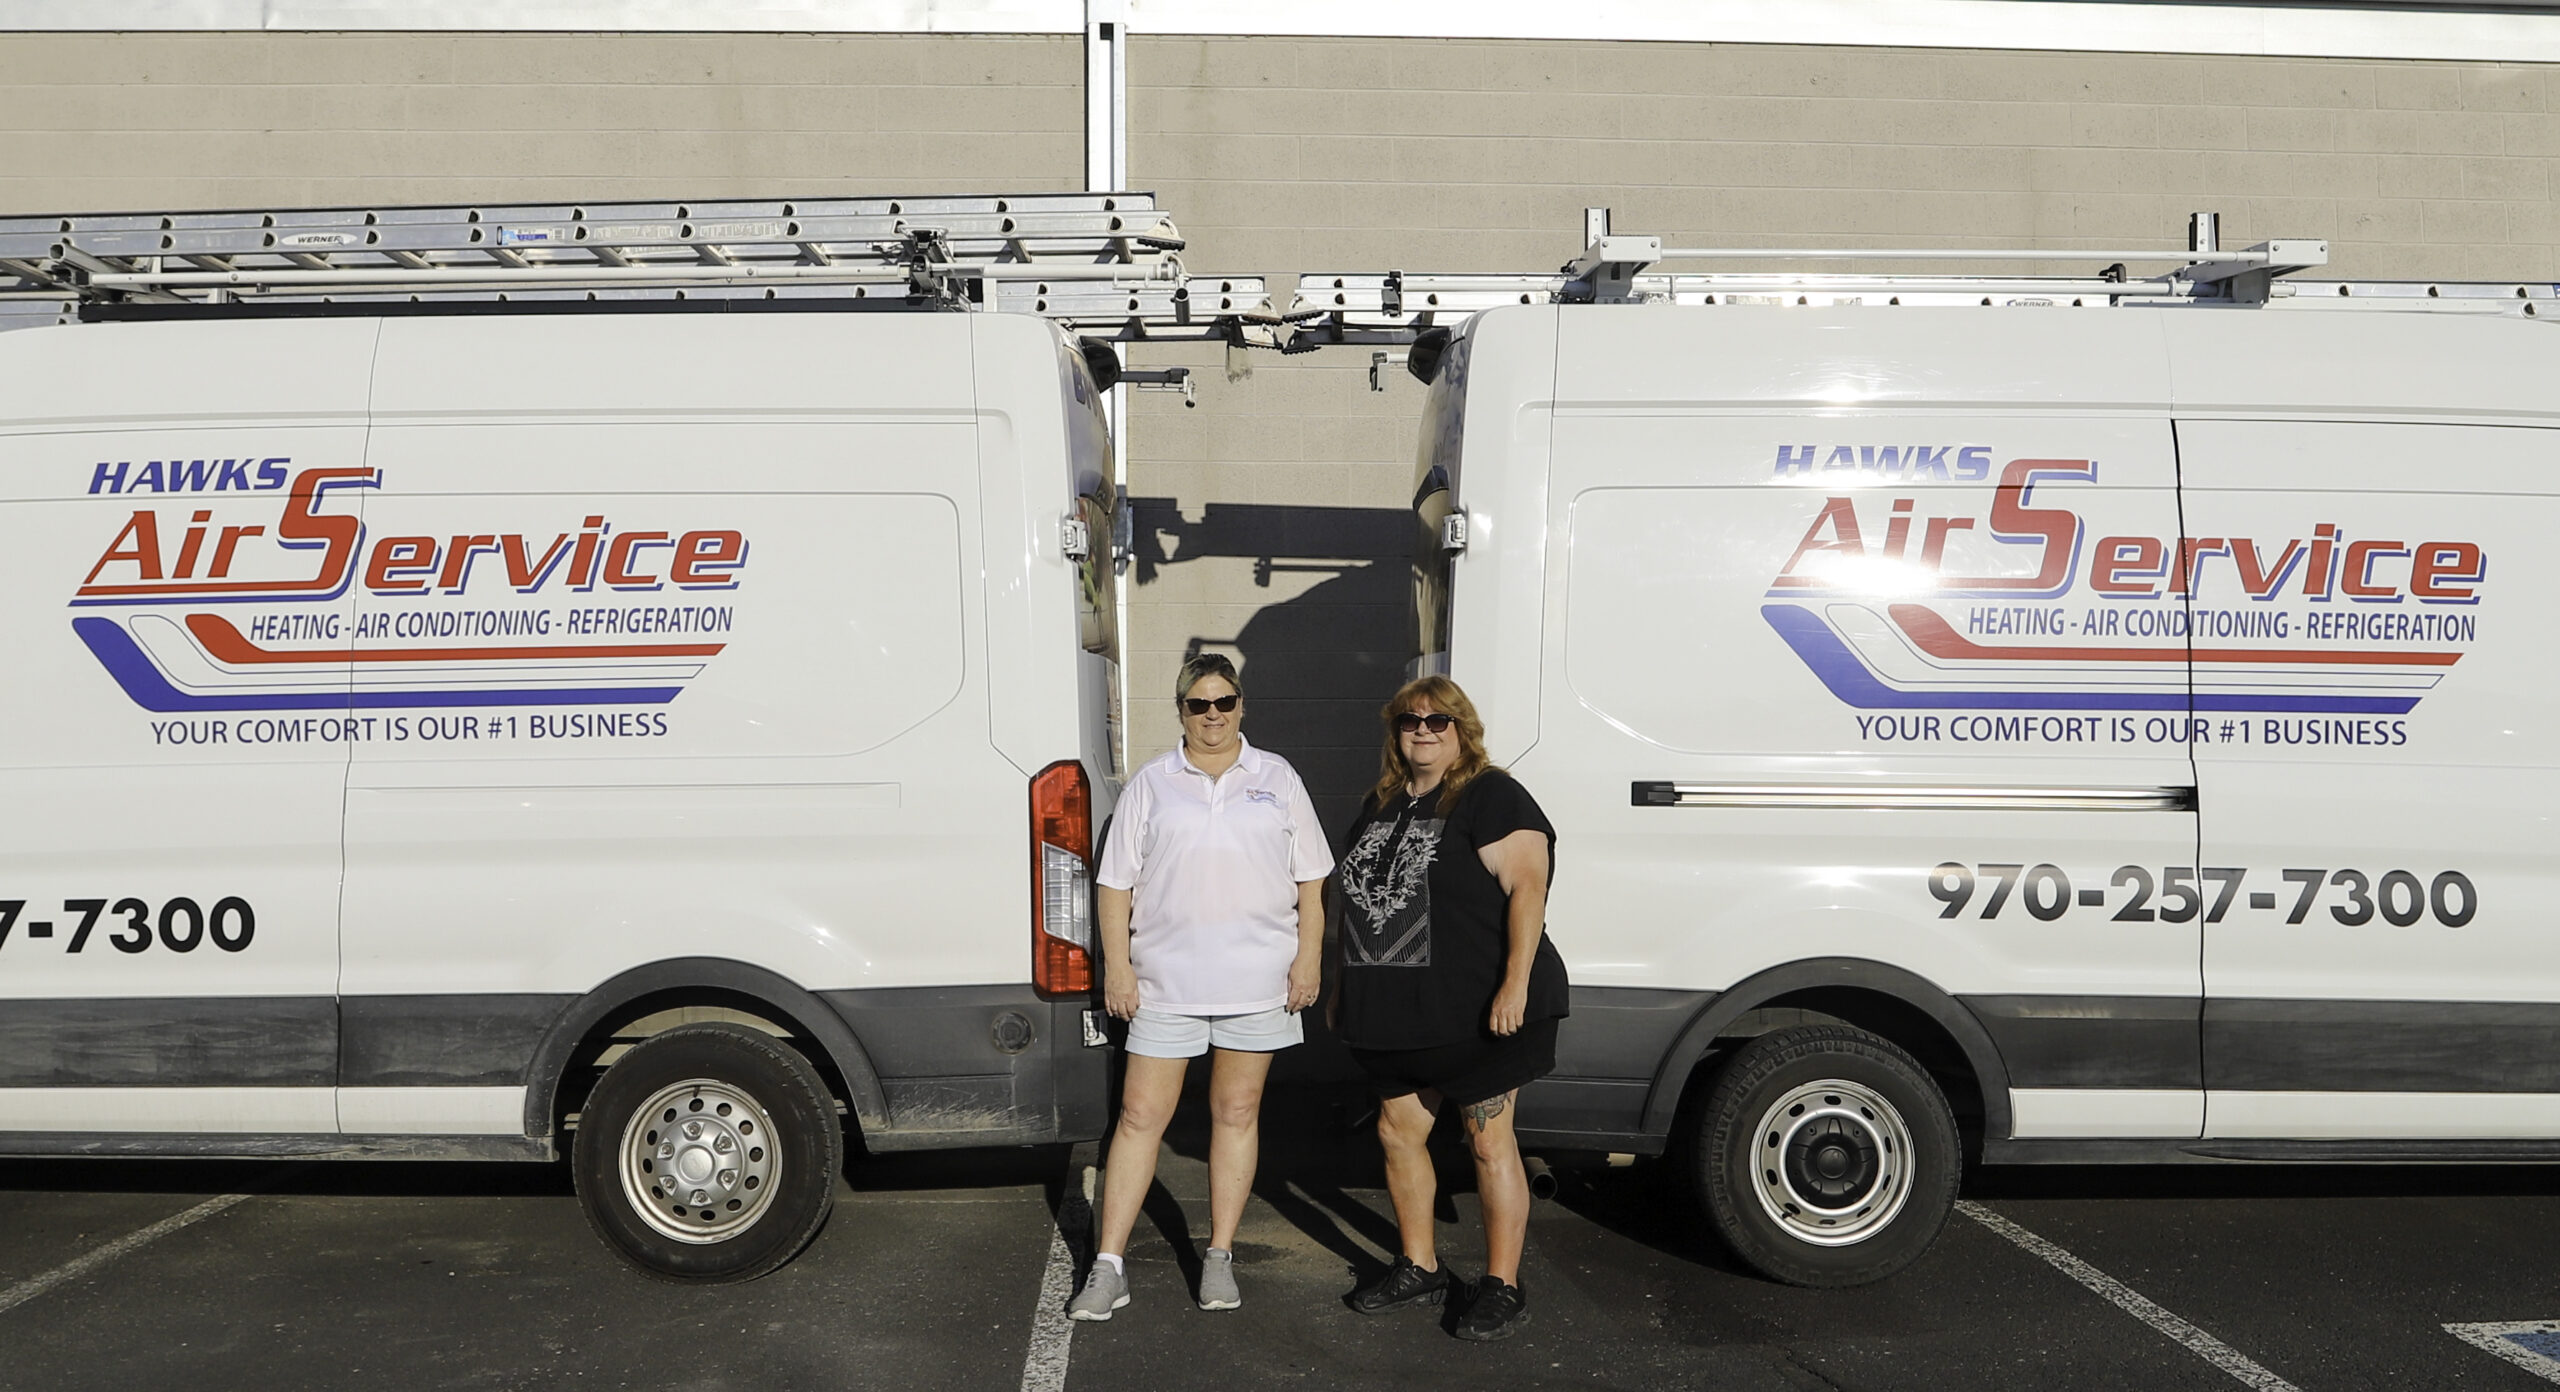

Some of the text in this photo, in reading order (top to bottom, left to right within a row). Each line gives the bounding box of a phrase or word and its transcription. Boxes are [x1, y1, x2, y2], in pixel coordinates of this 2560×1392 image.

[88, 458, 291, 494] HAWKS
[1773, 445, 1993, 481] HAWKS
[83, 510, 266, 584] Air
[249, 613, 340, 640] HEATING
[355, 612, 390, 638] AIR
[395, 610, 550, 638] CONDITIONING
[567, 606, 733, 634] REFRIGERATION
[1968, 607, 2065, 635] HEATING
[2082, 609, 2119, 636] AIR
[2124, 609, 2288, 638] CONDITIONING
[2306, 612, 2476, 641] REFRIGERATION
[151, 712, 668, 744] YOUR COMFORT IS OUR #1 BUSINESS
[1856, 716, 2407, 746] YOUR COMFORT IS OUR #1 BUSINESS
[1928, 861, 2478, 928] 970-257-7300
